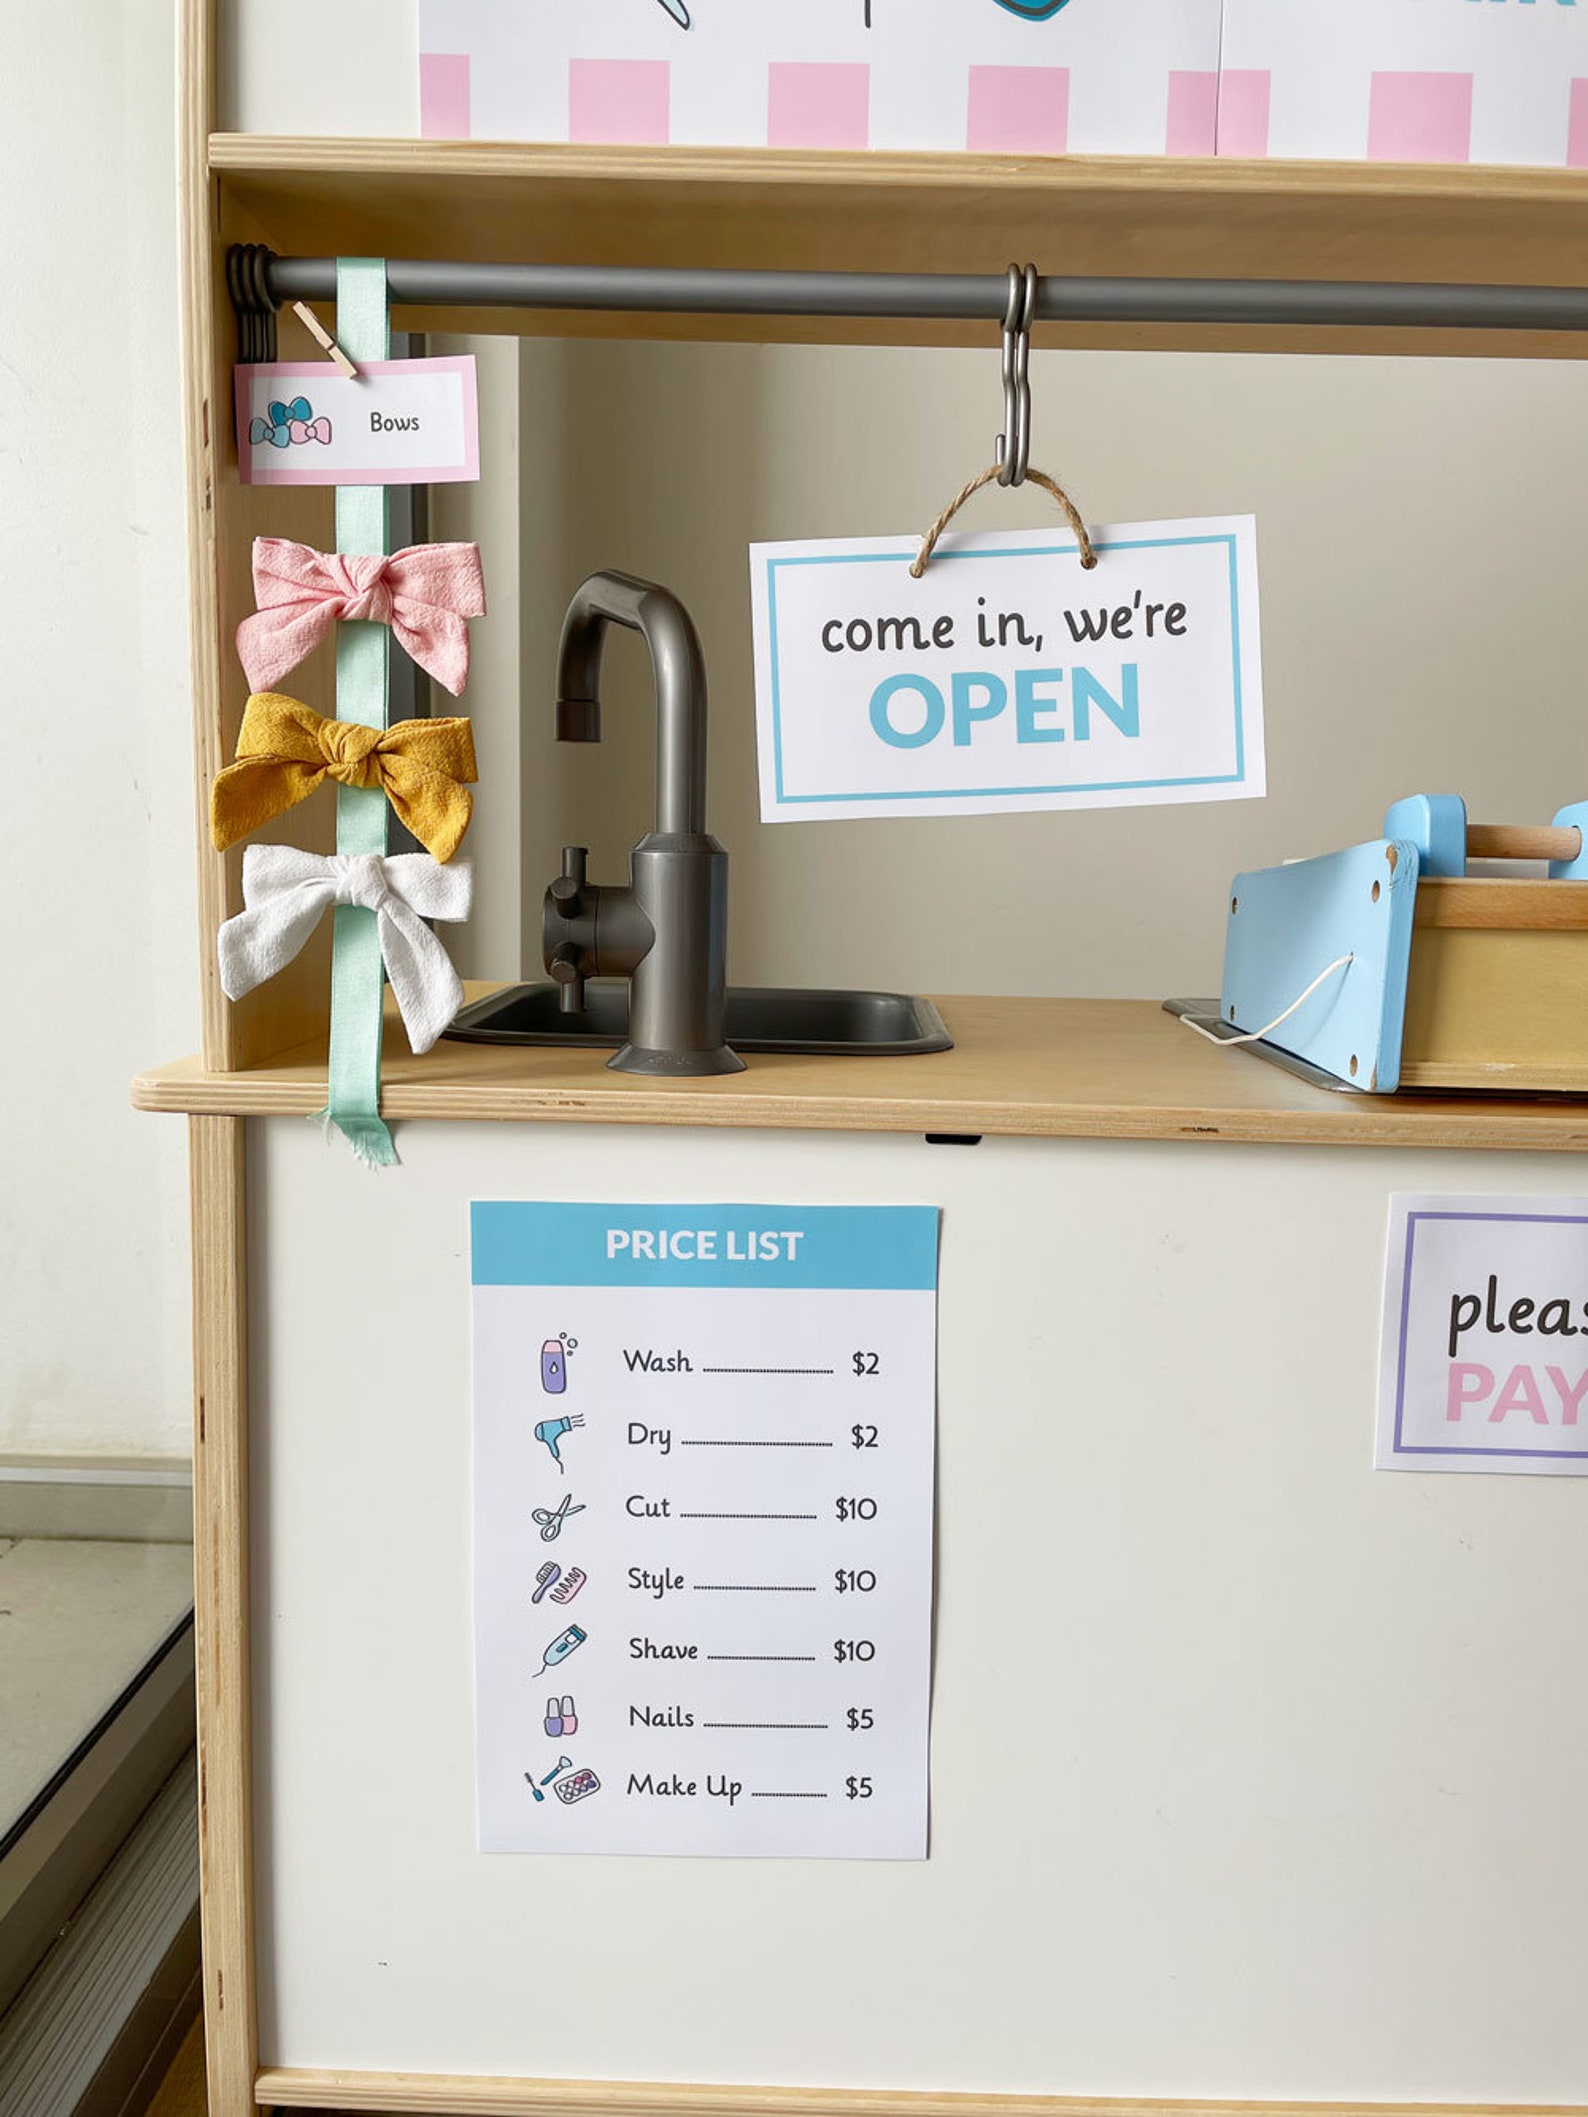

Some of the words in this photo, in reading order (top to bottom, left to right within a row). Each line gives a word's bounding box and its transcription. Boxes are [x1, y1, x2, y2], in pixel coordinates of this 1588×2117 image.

[370, 411, 420, 432] Bows
[822, 617, 955, 652] come
[978, 597, 1043, 651] in,
[1063, 590, 1187, 641] we're
[870, 664, 1139, 748] OPEN
[608, 1230, 716, 1259] PRICE
[728, 1231, 803, 1260] LIST
[623, 1350, 693, 1372] Wash
[852, 1352, 879, 1376] $2
[1447, 1363, 1588, 1425] PAY
[628, 1423, 671, 1454] Dry
[851, 1425, 878, 1449] $2
[626, 1495, 671, 1517] Cut
[836, 1497, 877, 1521] $10
[628, 1568, 684, 1598] Style
[835, 1569, 876, 1593] $10
[630, 1638, 698, 1659] Shave
[834, 1640, 875, 1663] $10
[630, 1706, 694, 1727] Nails
[847, 1707, 874, 1731] $5
[627, 1774, 696, 1796] Make
[707, 1775, 742, 1805] Up
[846, 1776, 873, 1800] $5
